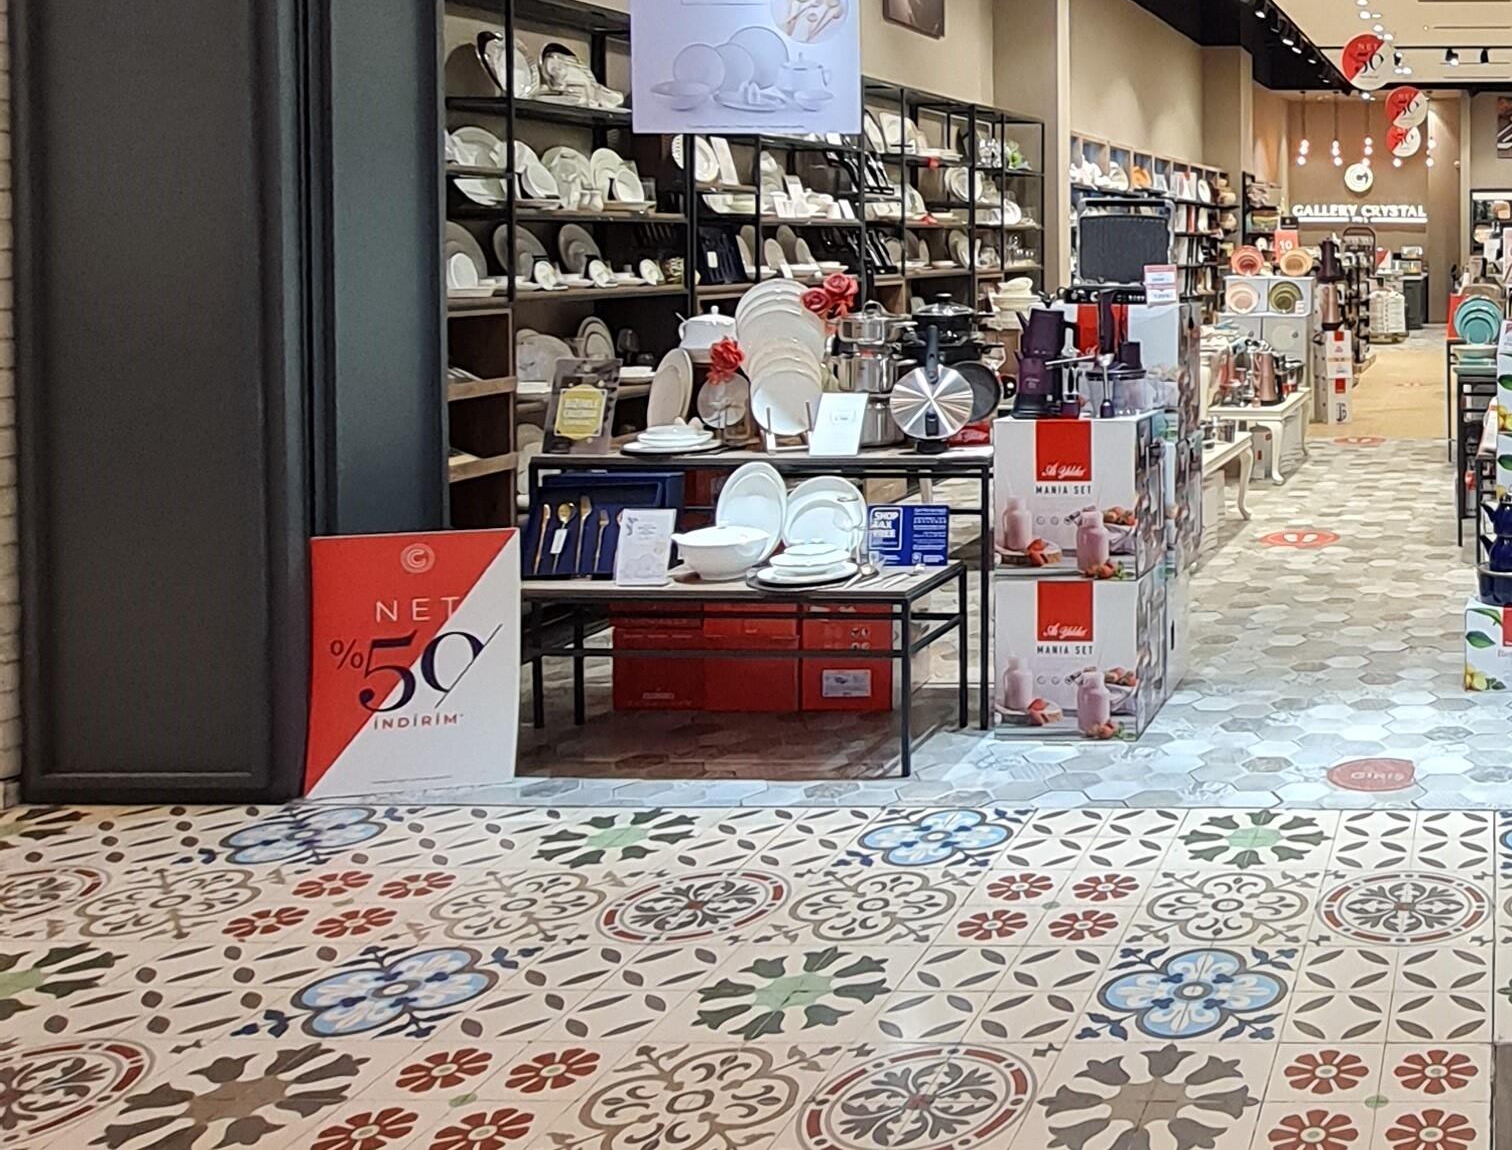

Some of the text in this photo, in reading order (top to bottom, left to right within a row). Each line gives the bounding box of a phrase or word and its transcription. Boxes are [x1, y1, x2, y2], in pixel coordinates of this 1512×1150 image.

[1292, 204, 1427, 217] GALLERY CRYSTAL
[1036, 485, 1091, 495] MANIA SET
[375, 596, 460, 622] NET
[1037, 645, 1093, 655] MANIA SET
